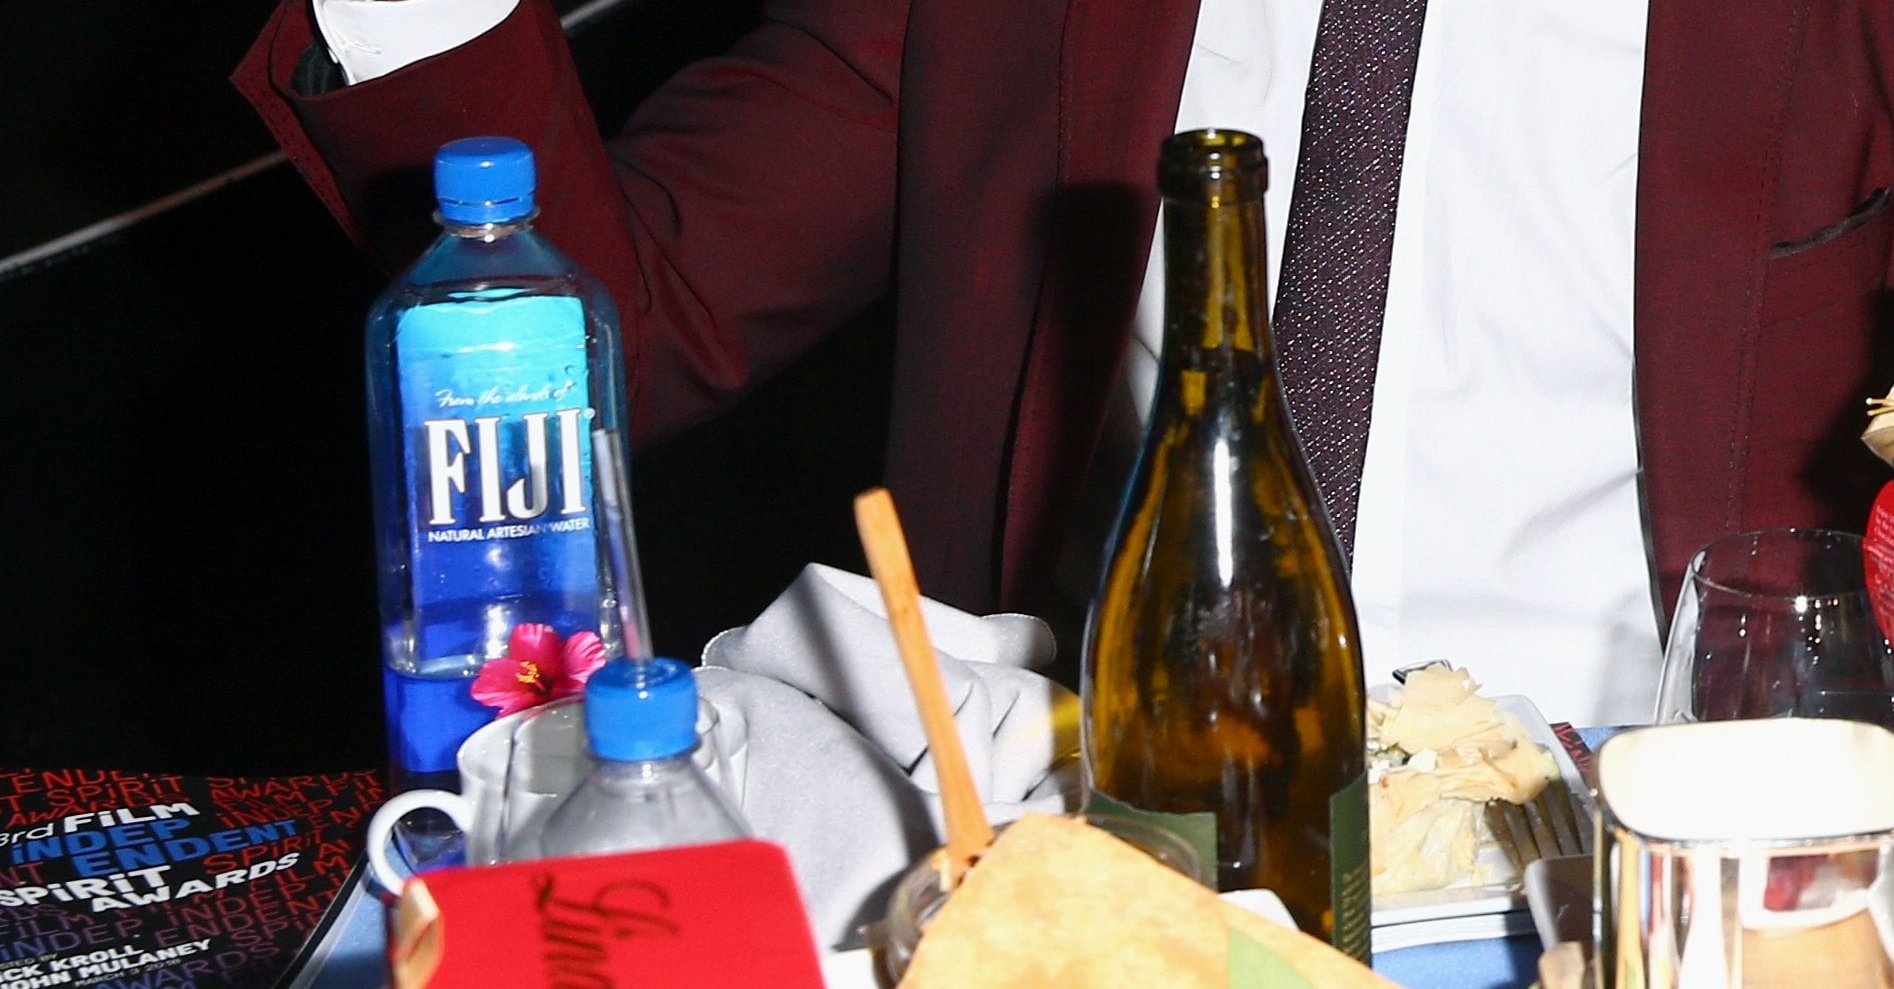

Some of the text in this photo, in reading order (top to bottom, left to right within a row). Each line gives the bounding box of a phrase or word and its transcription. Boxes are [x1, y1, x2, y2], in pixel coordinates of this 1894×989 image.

[435, 389, 475, 408] From
[477, 386, 502, 405] the
[552, 380, 577, 402] of
[424, 408, 586, 526] FIJI
[428, 517, 591, 543] NATURAL ARTESIAN WATER
[72, 820, 297, 878] ENDENT
[91, 852, 300, 913] AWARDS
[0, 944, 145, 983] CK KROLL
[77, 938, 211, 980] MULANEY
